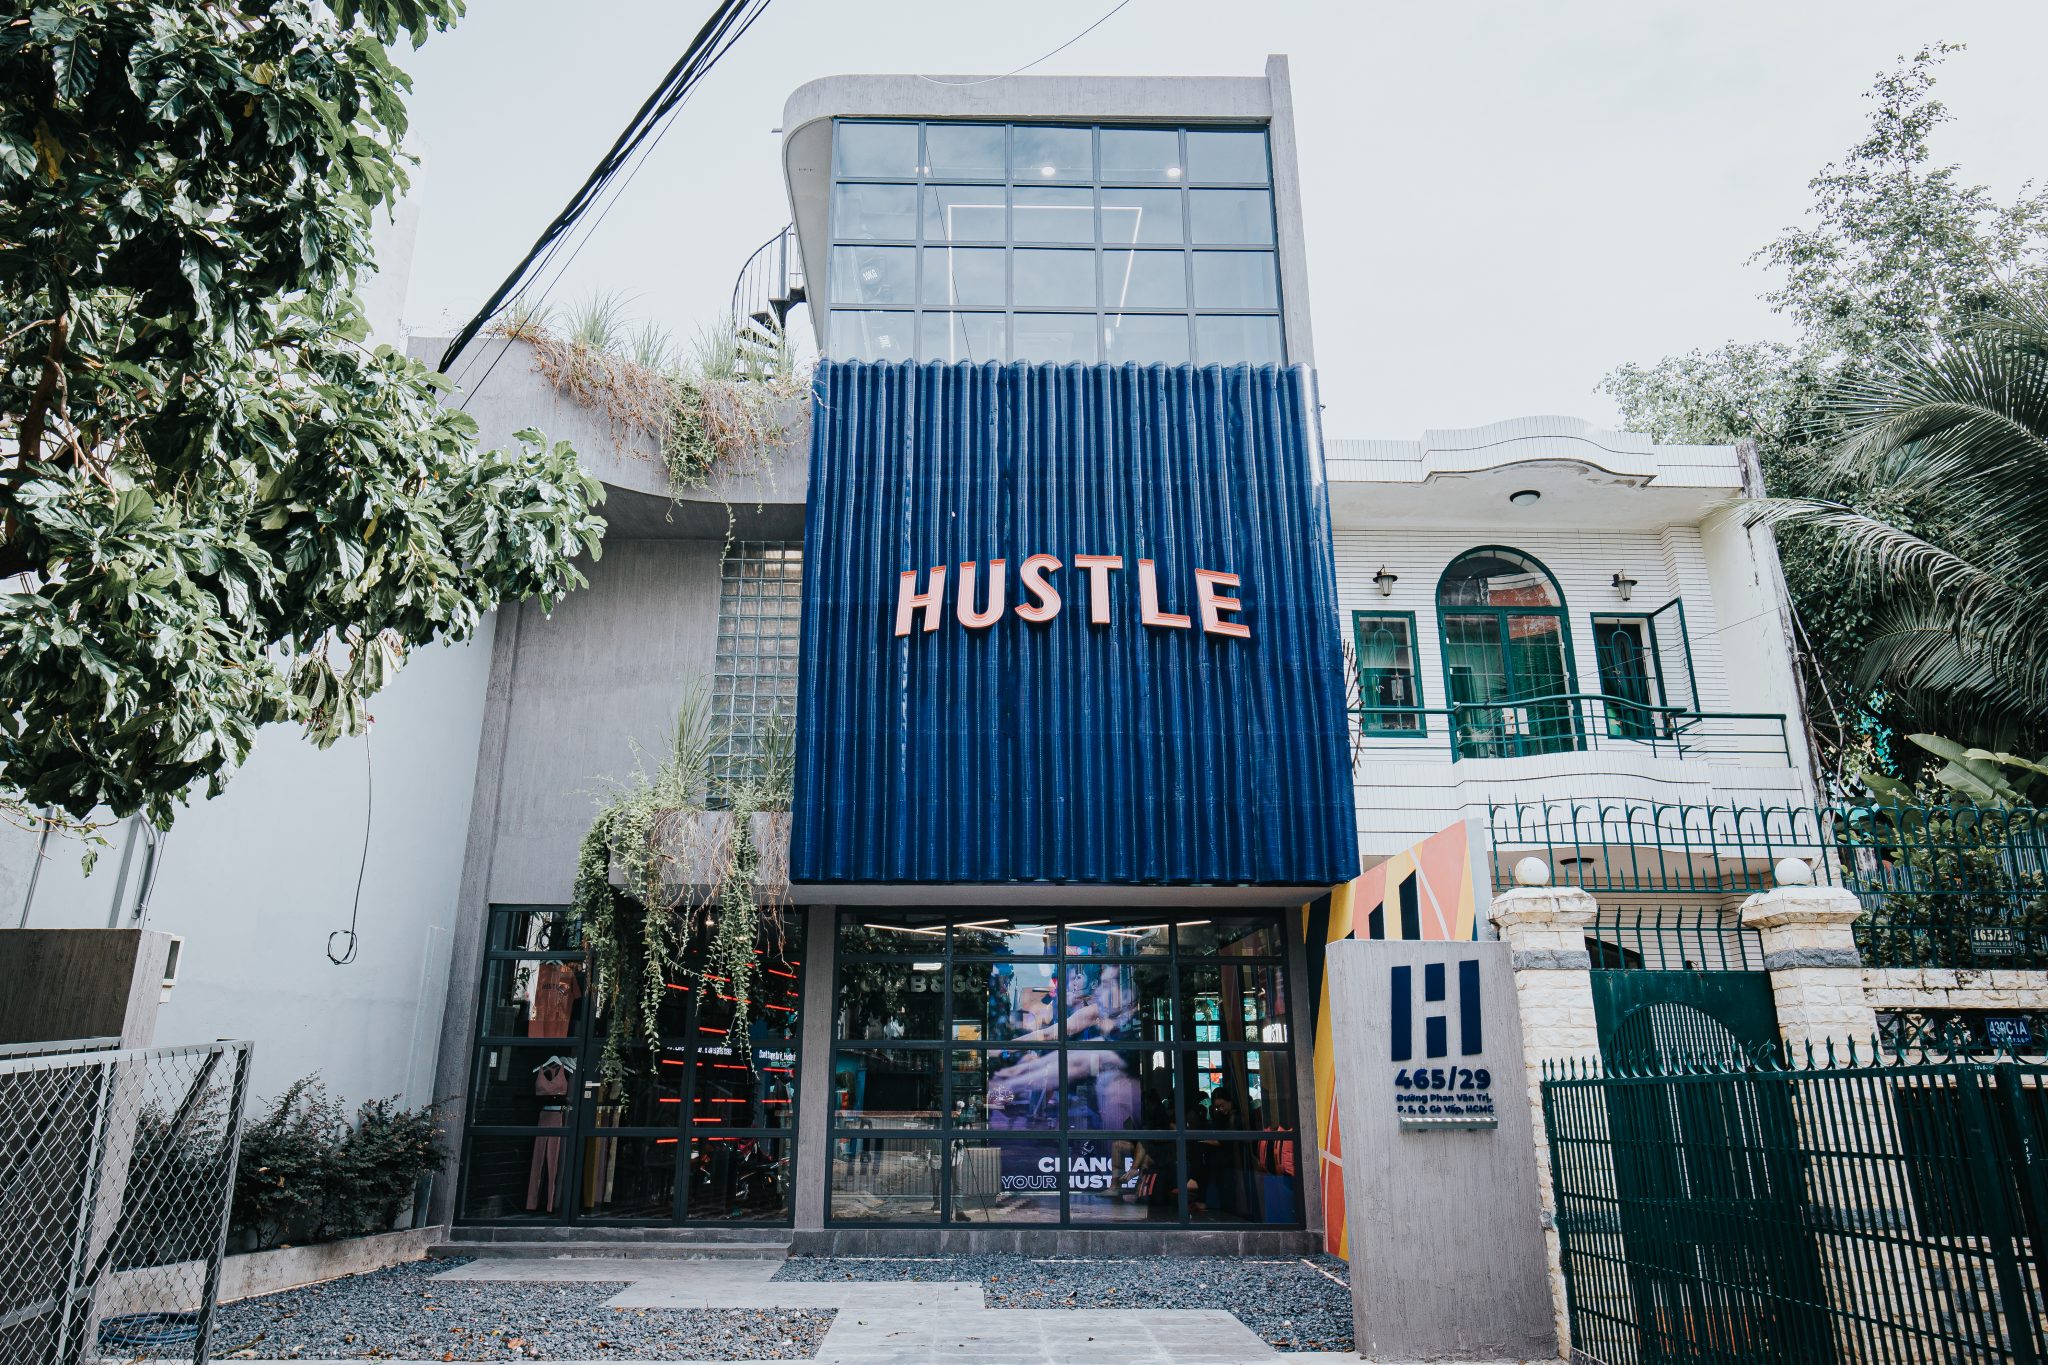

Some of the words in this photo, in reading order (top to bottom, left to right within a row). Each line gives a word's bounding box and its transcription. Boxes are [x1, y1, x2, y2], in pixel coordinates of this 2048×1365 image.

[895, 554, 1251, 638] HUSTLE
[1973, 930, 2011, 941] 465/25
[953, 974, 983, 993] GO
[1395, 1065, 1491, 1091] 465/29
[1430, 1093, 1454, 1102] Phan
[1466, 1105, 1495, 1114] HCMC
[1001, 1175, 1057, 1189] YOUR
